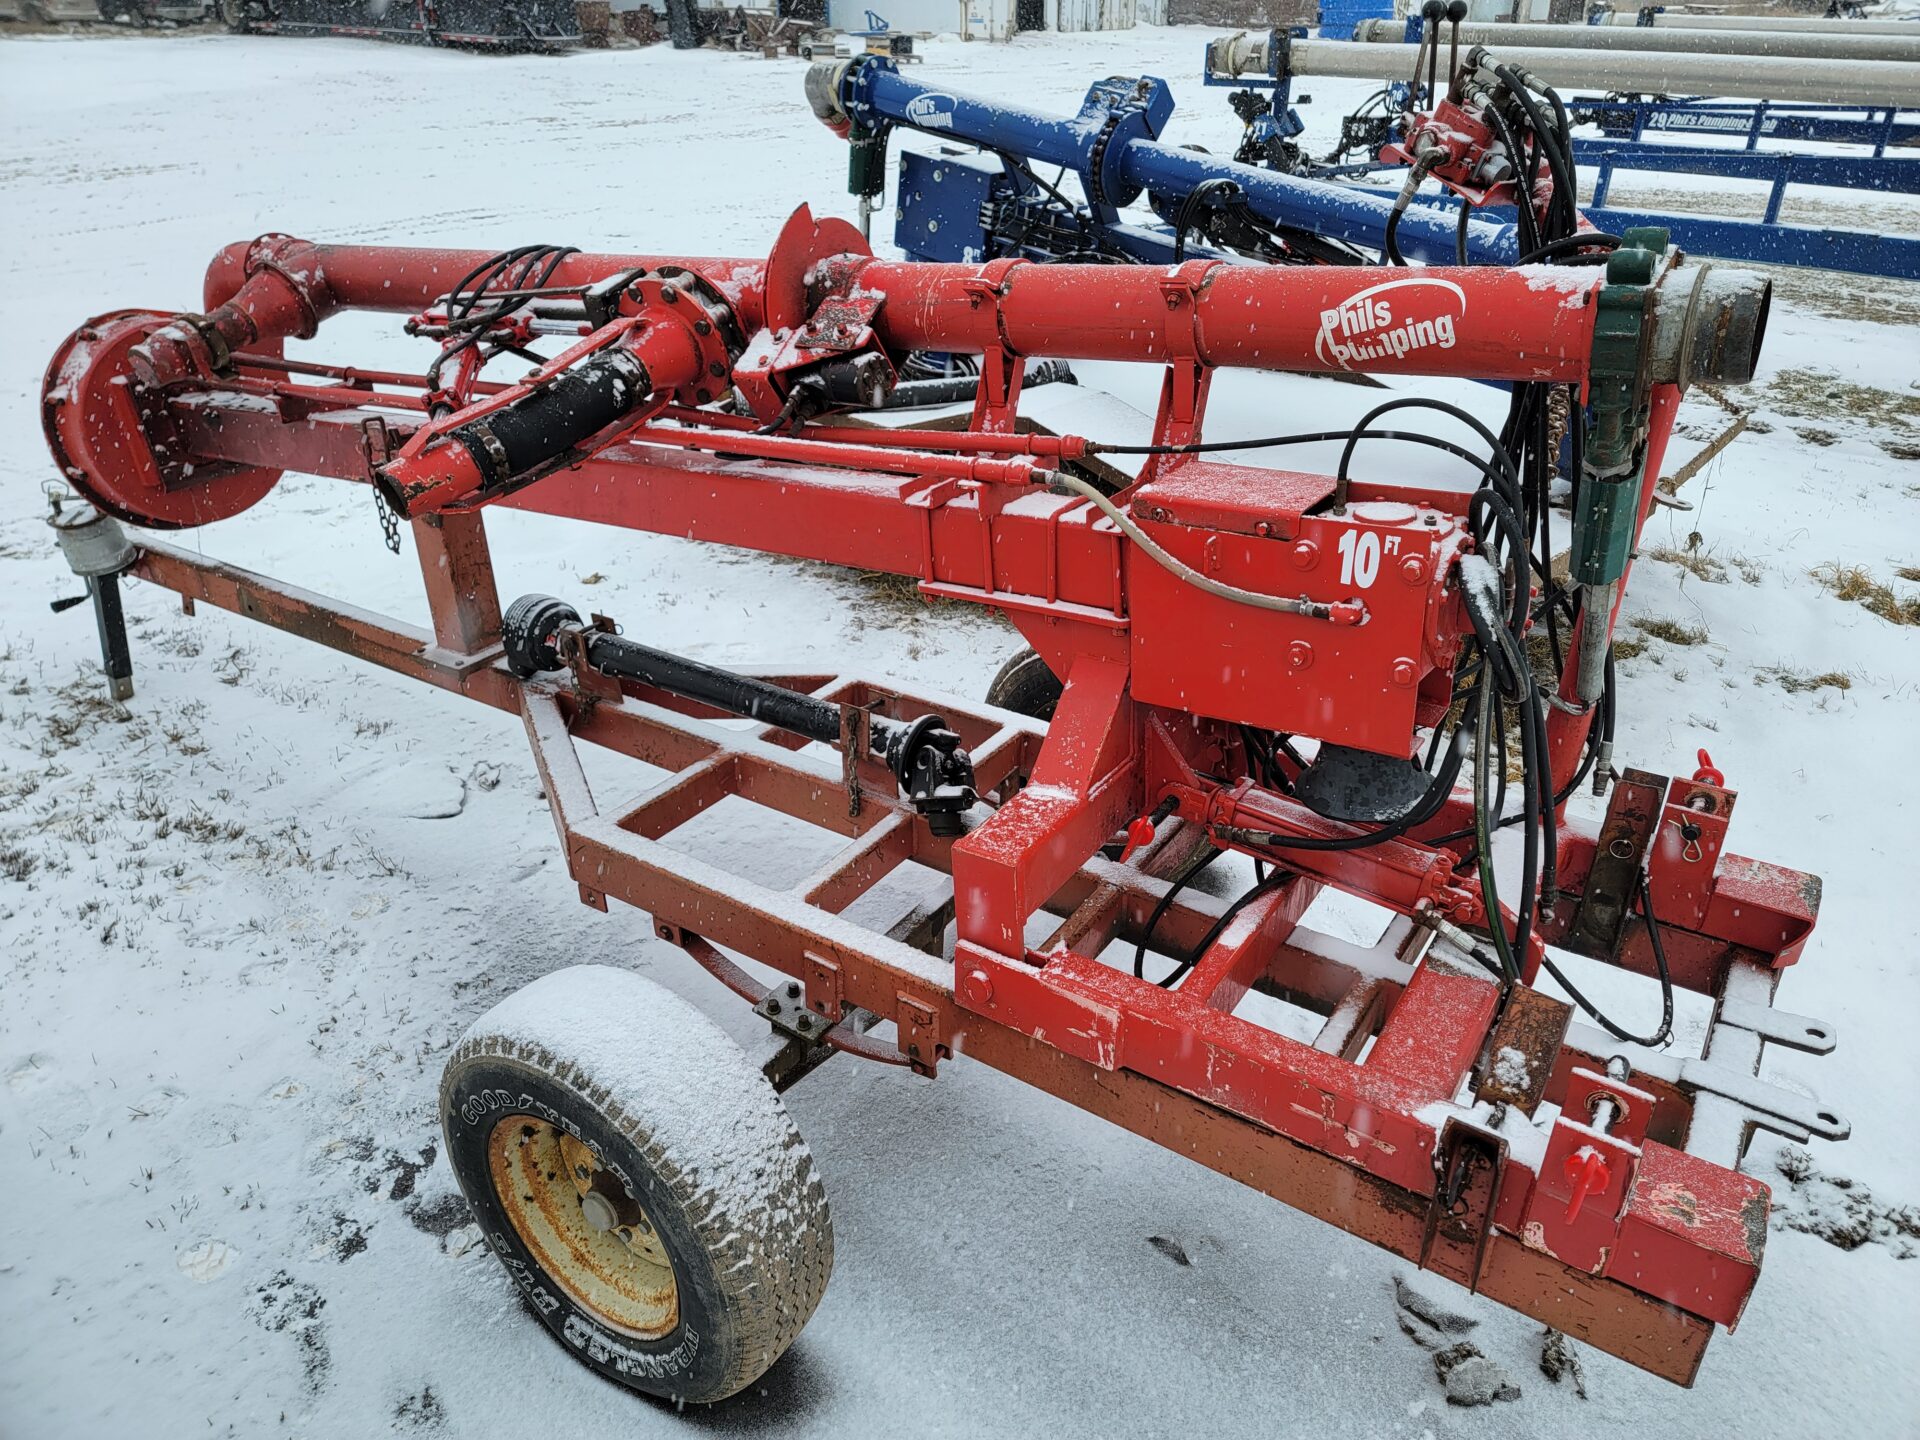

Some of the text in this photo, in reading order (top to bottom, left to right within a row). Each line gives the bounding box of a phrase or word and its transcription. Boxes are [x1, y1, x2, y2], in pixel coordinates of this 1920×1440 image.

[1648, 111, 1668, 131] 29
[1338, 529, 1402, 589] 10 FT
[563, 1314, 700, 1378] WRANGLER
